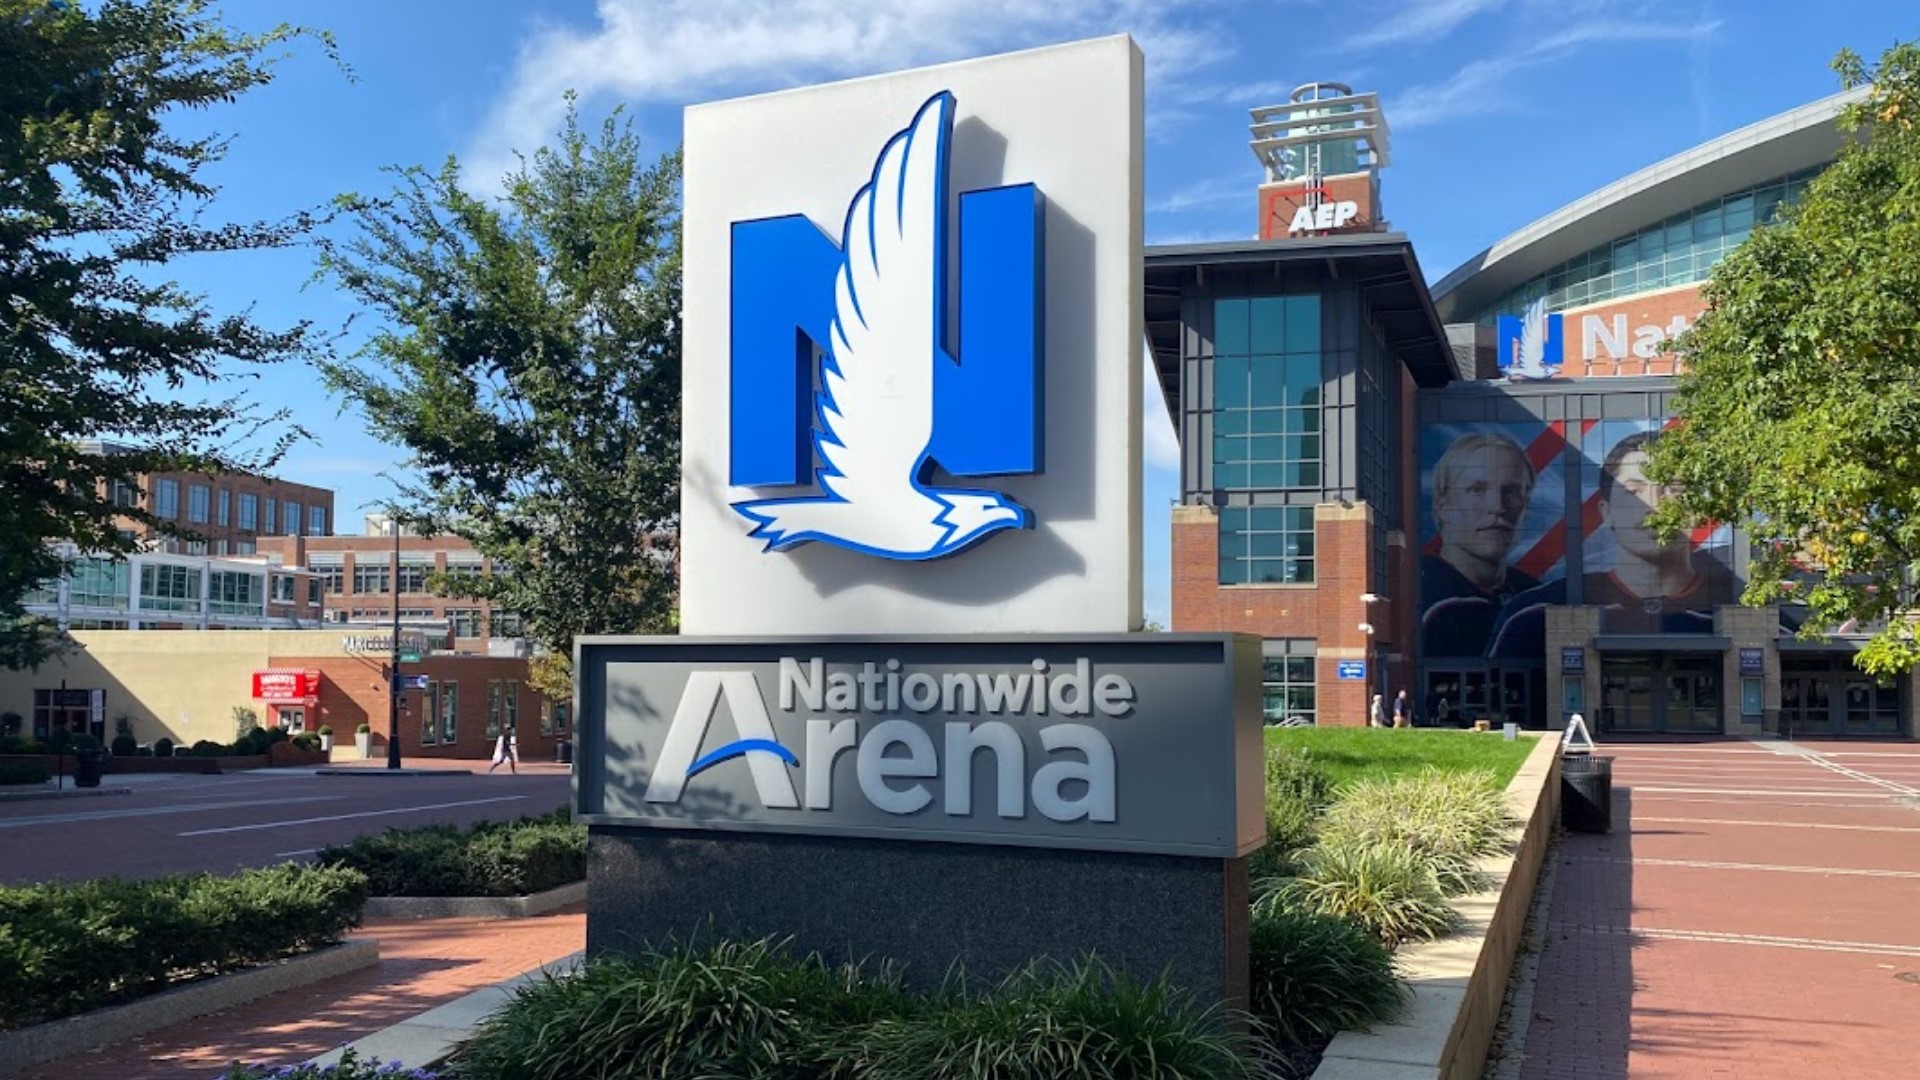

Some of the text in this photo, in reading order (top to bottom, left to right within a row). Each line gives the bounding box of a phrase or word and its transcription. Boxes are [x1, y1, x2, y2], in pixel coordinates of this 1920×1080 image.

[1288, 201, 1358, 232] AEP
[779, 657, 1134, 716] Nationwide
[644, 670, 1116, 823] Arena
